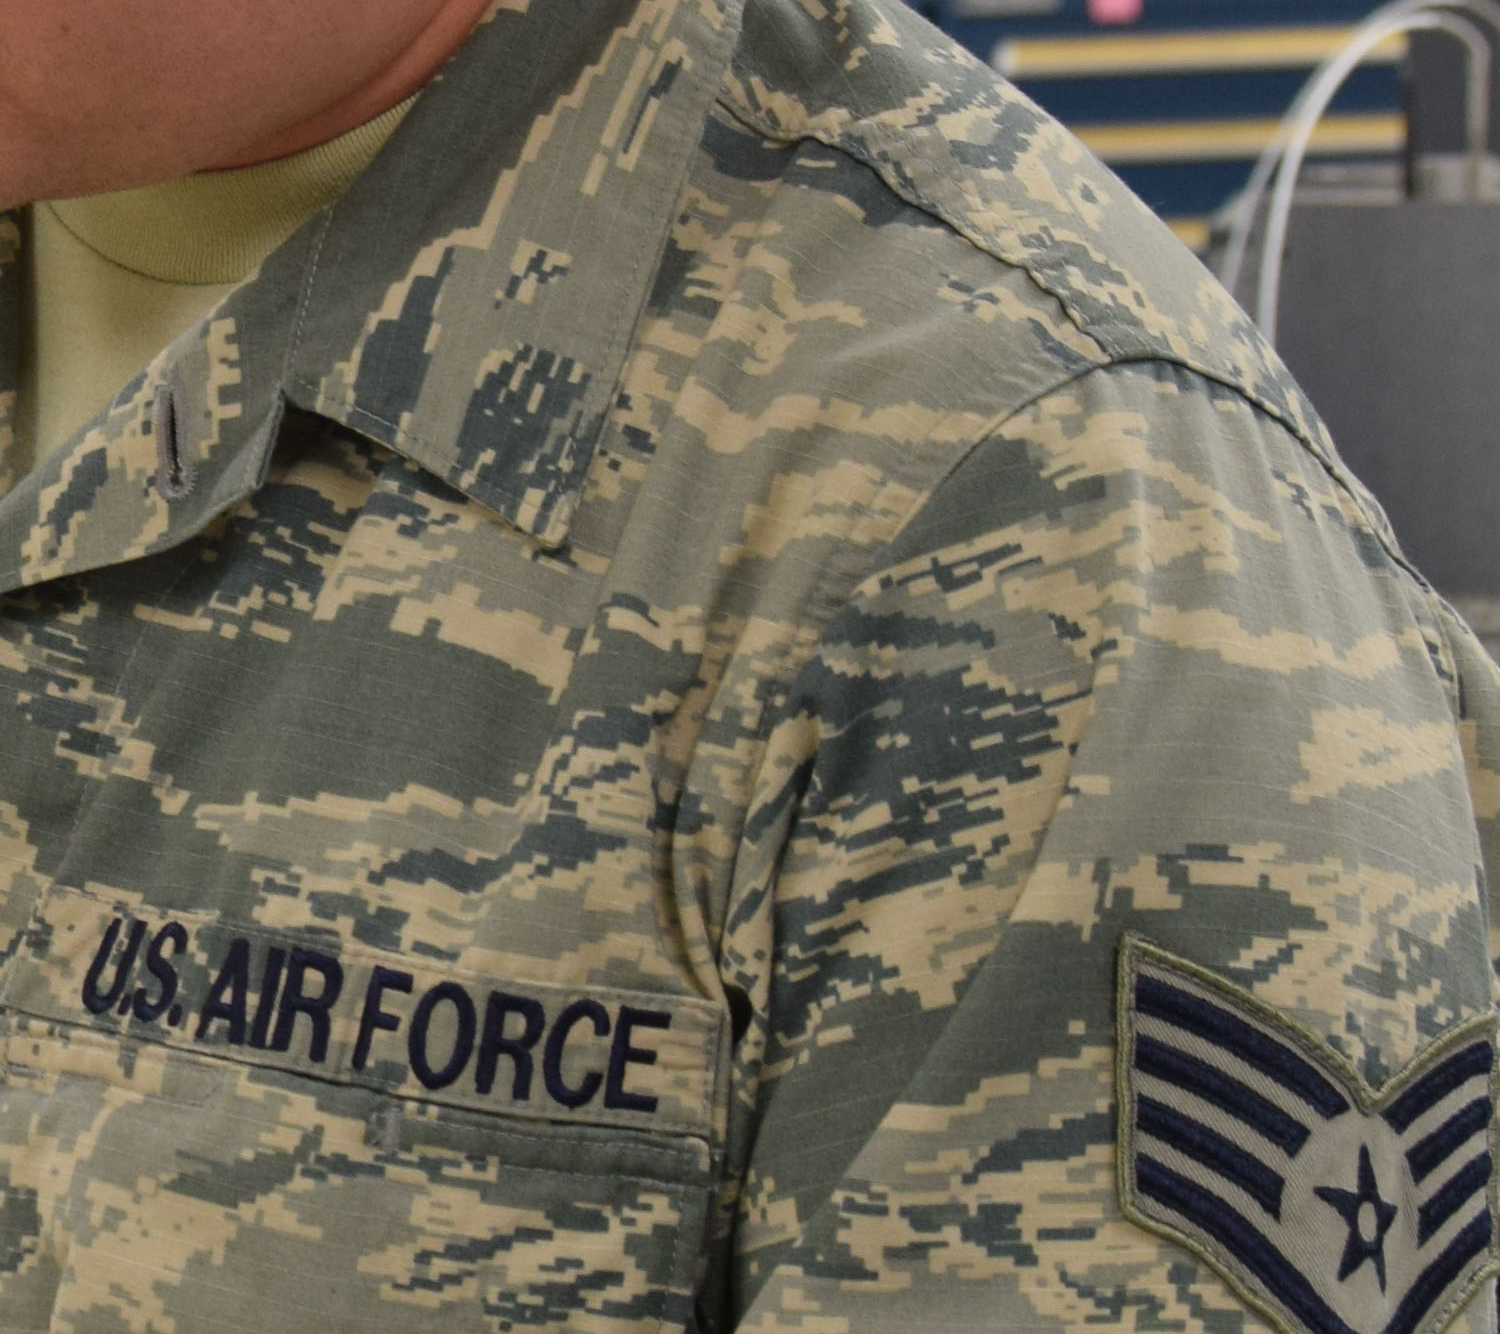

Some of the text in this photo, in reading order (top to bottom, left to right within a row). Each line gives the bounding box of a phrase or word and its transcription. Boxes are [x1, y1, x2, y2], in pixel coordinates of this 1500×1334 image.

[81, 916, 673, 1114] U.S. AIR FORCE
